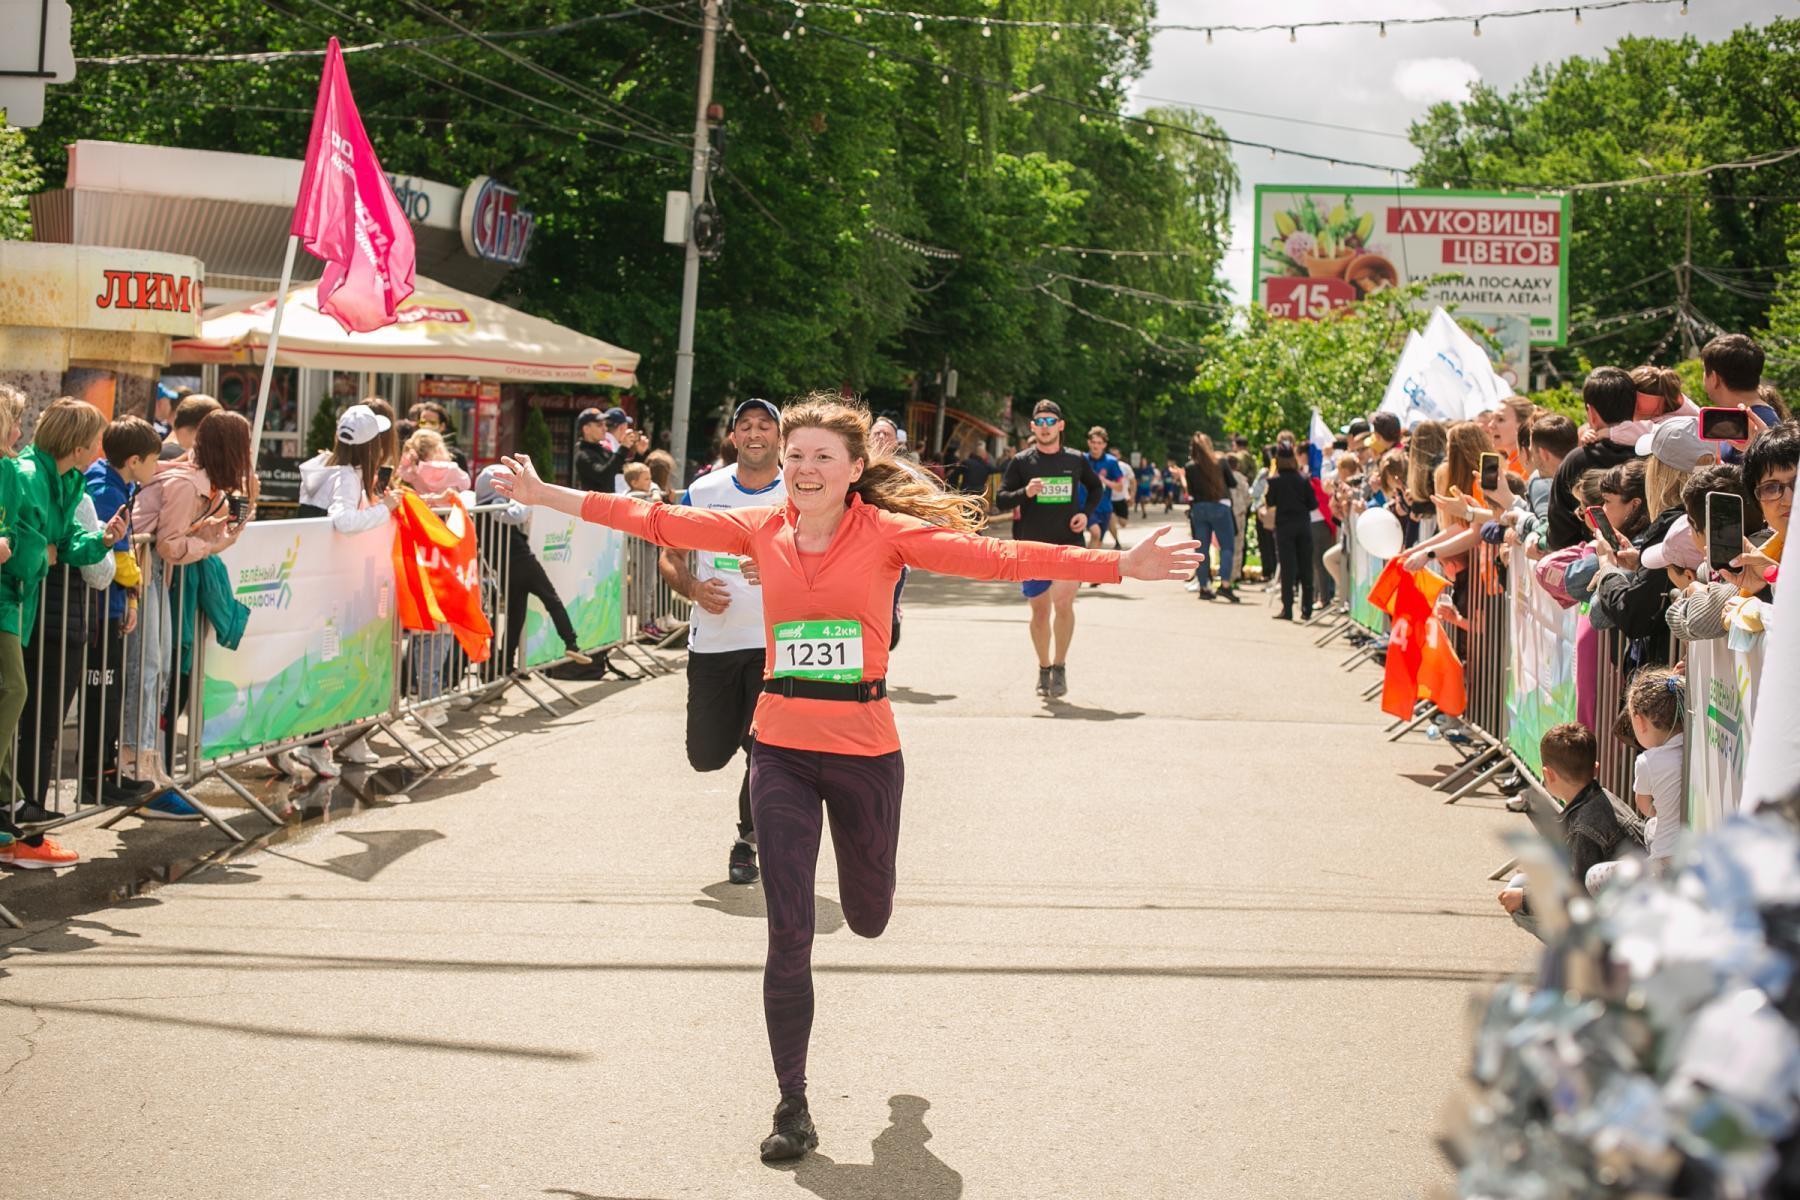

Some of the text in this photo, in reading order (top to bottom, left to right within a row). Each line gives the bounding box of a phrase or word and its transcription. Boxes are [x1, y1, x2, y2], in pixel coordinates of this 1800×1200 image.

[1398, 209, 1554, 236] ЛУКОВИЦЫ
[1454, 241, 1554, 265] ЦВЕТОВ
[1479, 276, 1553, 290] ПОСАДКУ
[787, 642, 845, 666] 1231
